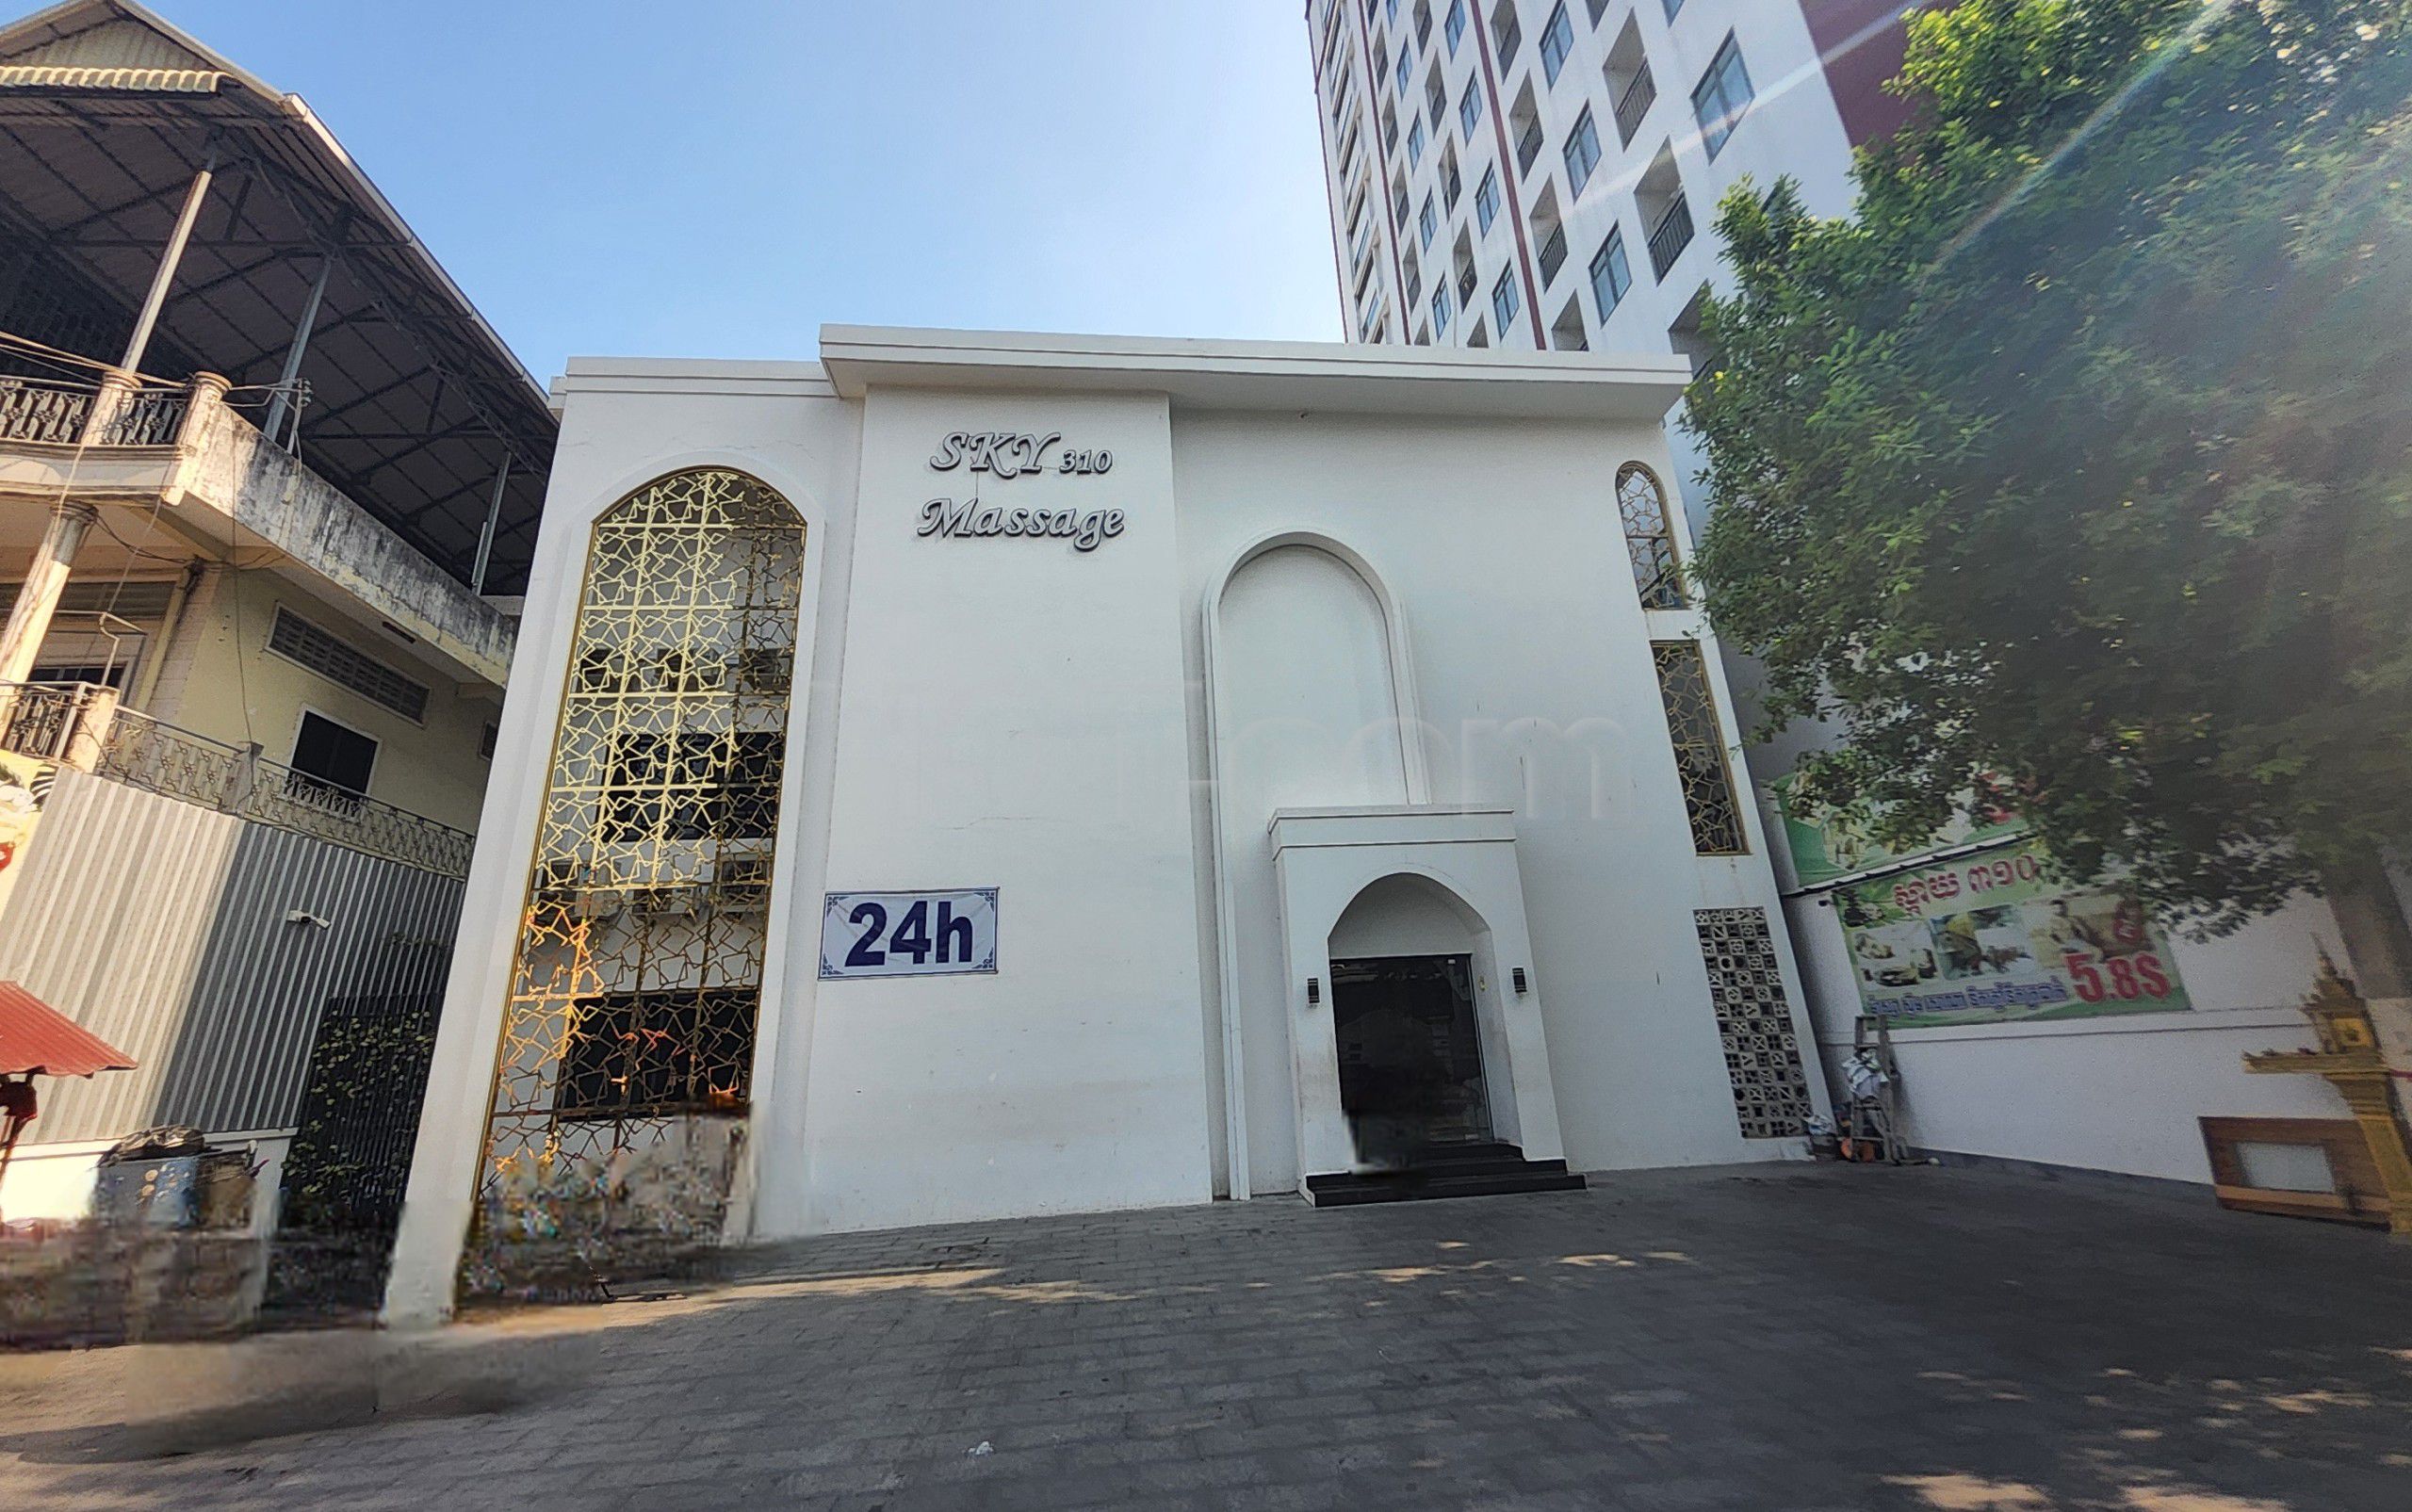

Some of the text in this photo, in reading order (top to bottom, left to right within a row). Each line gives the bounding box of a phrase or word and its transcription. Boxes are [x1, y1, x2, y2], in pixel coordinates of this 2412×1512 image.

[930, 431, 1113, 480] SKY 310
[917, 497, 1125, 552] Massage
[845, 901, 973, 967] 24h
